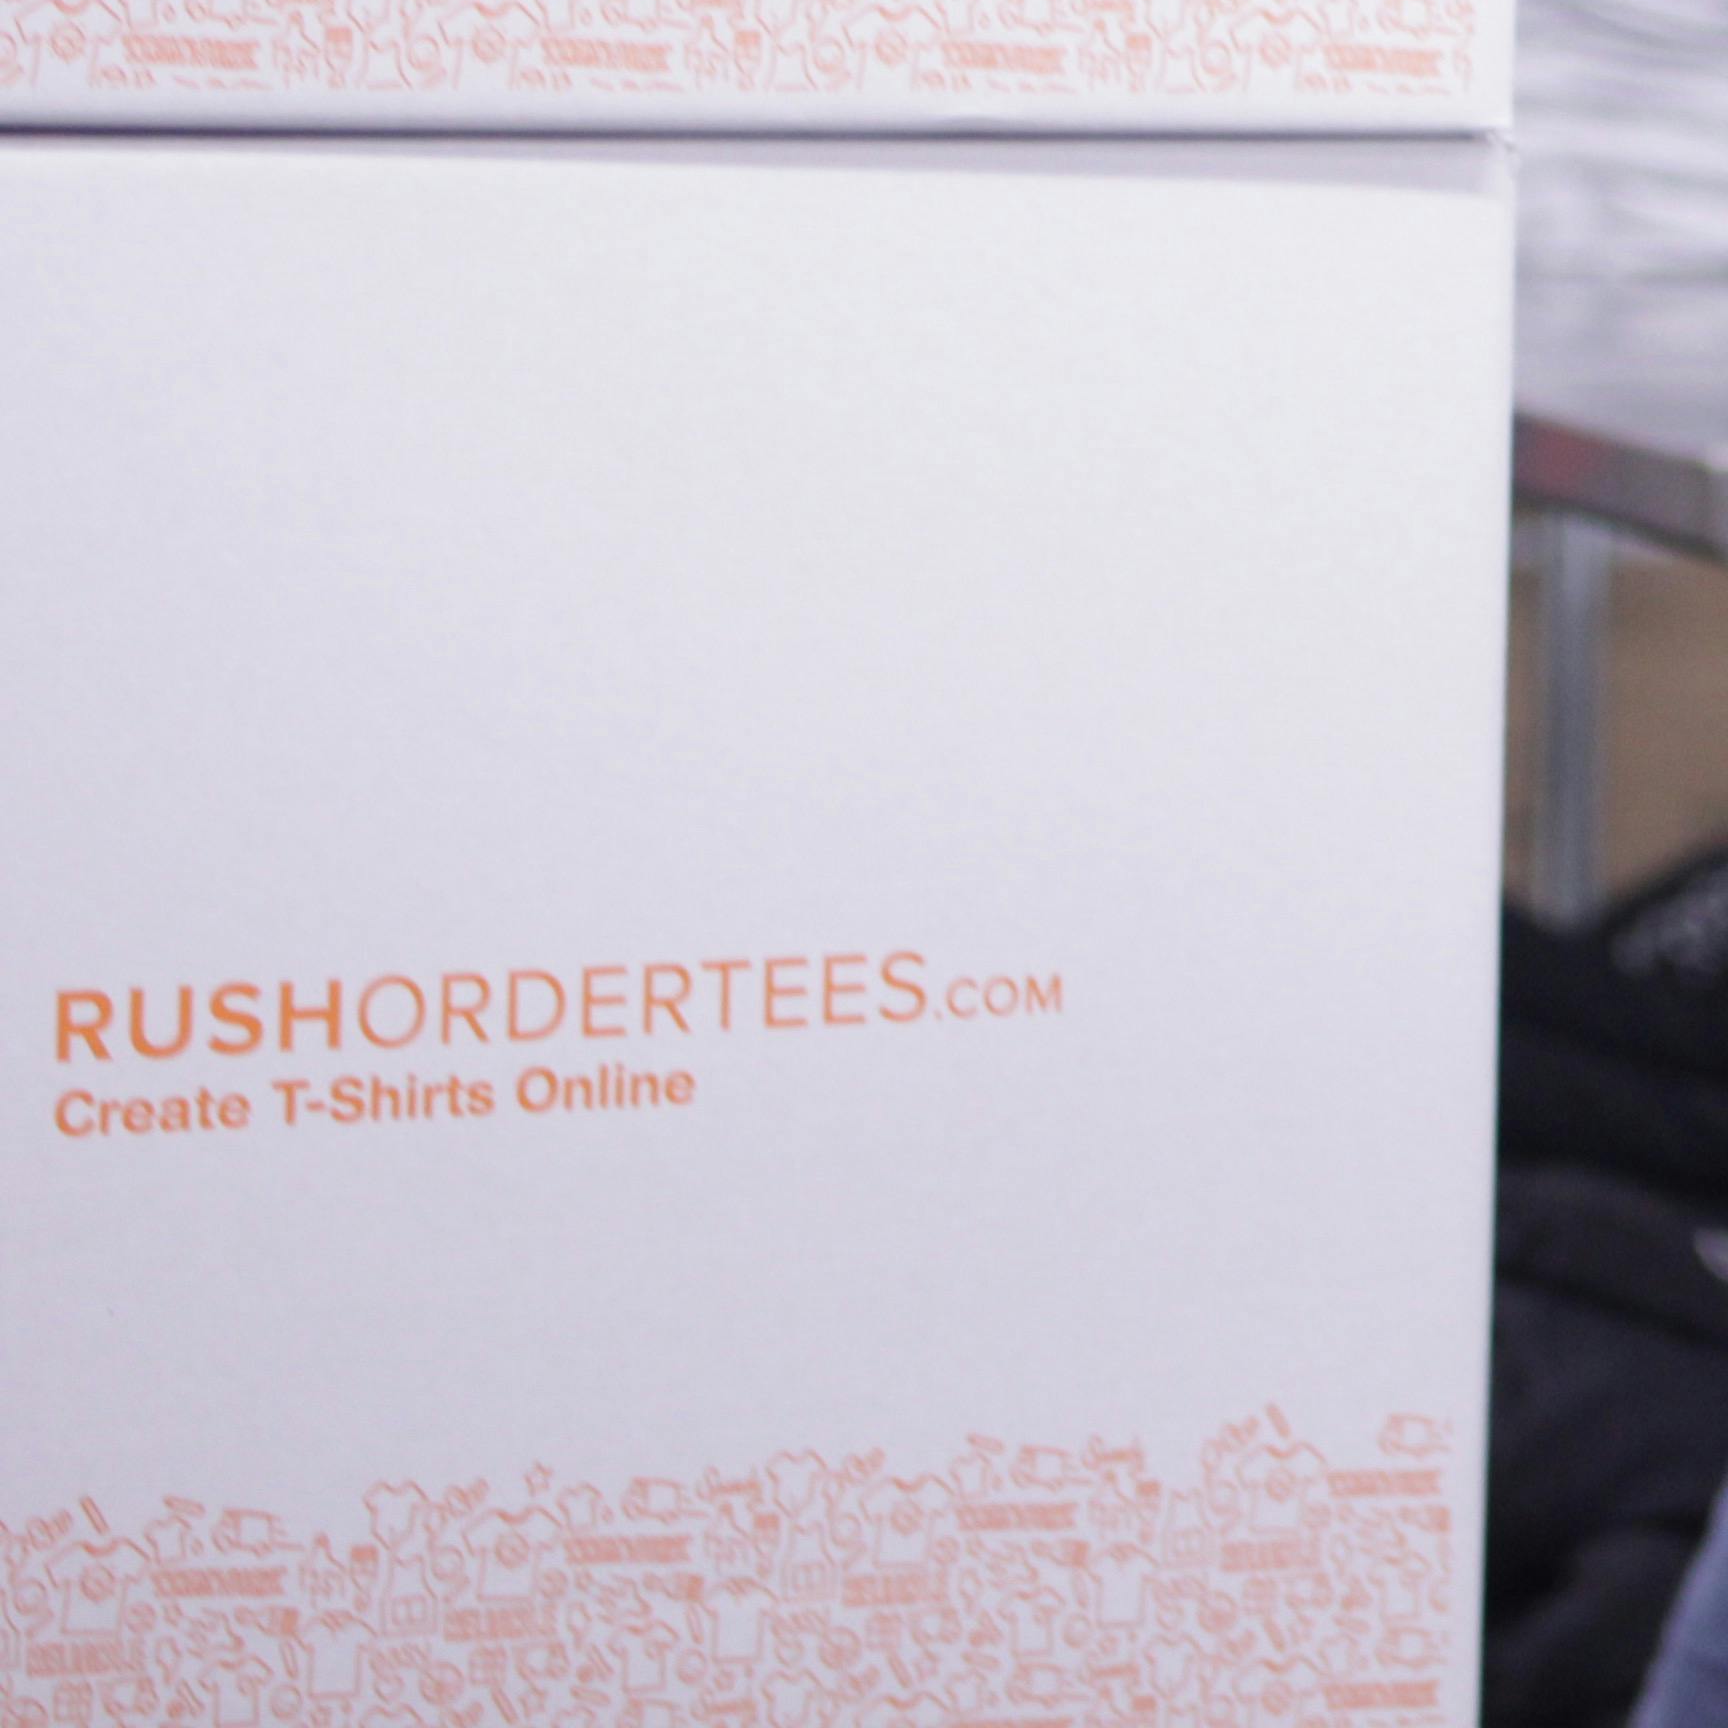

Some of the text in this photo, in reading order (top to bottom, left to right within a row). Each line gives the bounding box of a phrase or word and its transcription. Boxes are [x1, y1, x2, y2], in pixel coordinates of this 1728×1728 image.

[54, 949, 1065, 1064] RUSHORDERTEES.COM
[53, 1063, 697, 1139] Create T-Shirts Online
